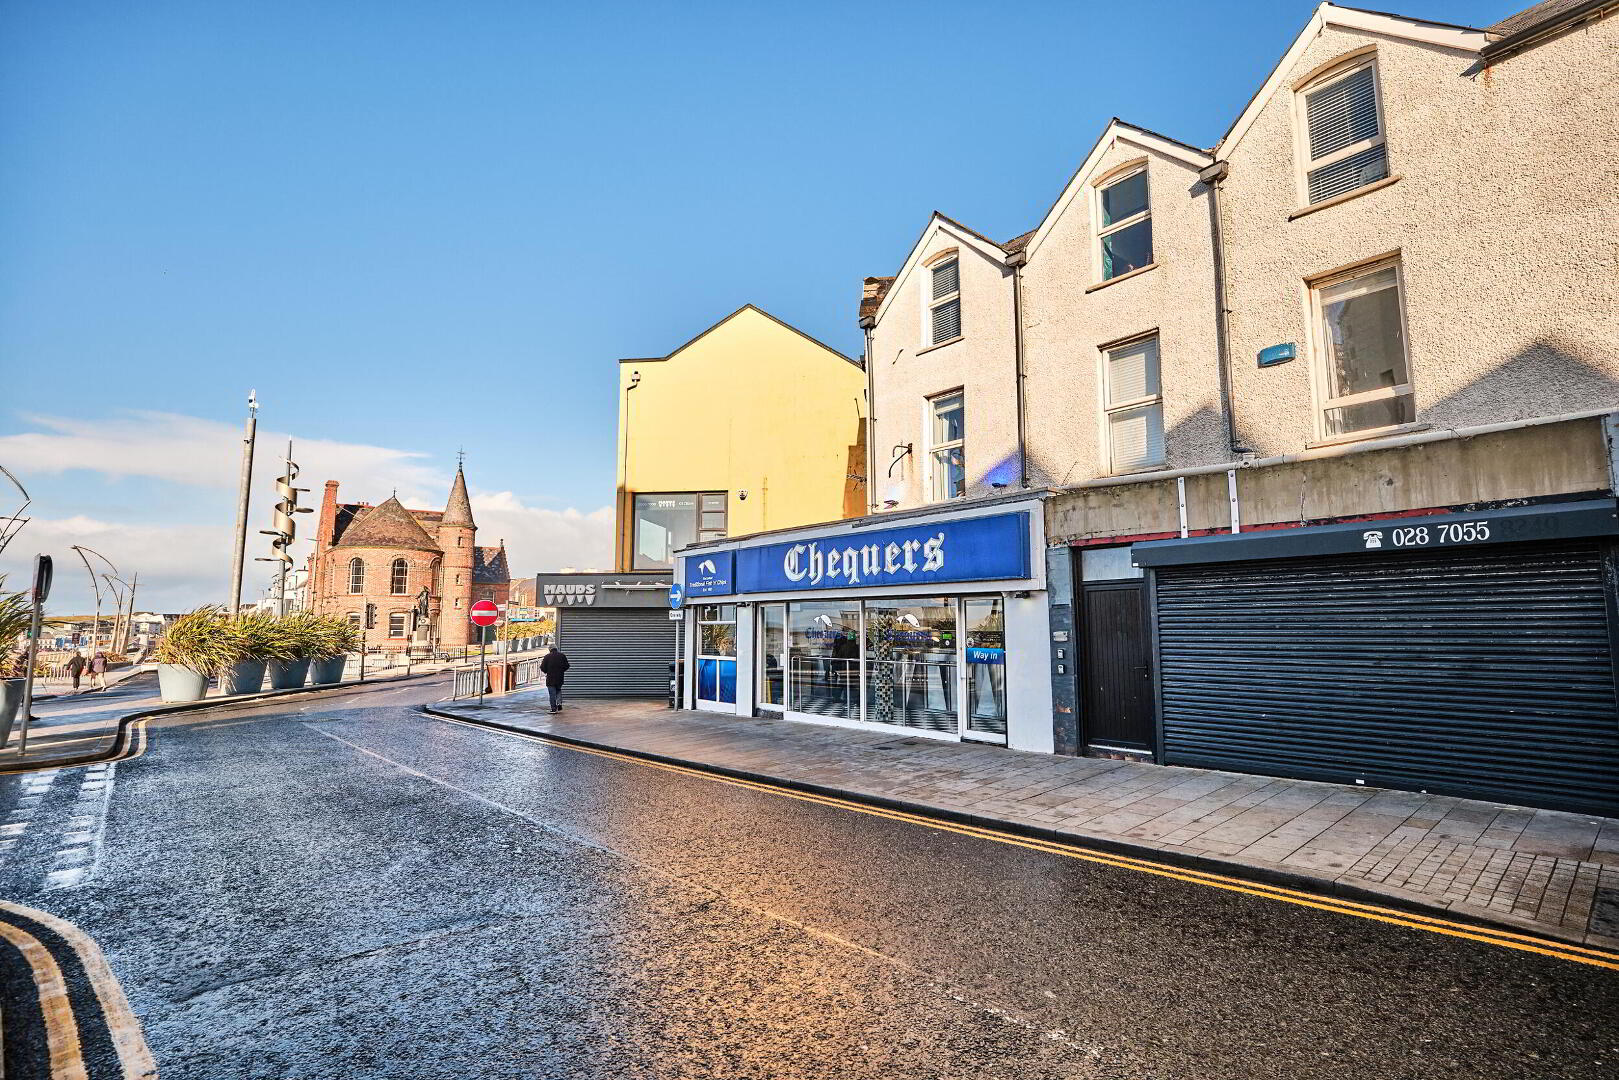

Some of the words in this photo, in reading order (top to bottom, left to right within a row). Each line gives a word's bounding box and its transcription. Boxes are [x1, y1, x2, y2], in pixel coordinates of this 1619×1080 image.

[1392, 526, 1430, 547] 028
[1437, 520, 1491, 543] 7055
[784, 532, 945, 585] Chequers
[543, 584, 597, 595] MAUDS
[973, 650, 989, 661] Way
[990, 651, 998, 660] in
